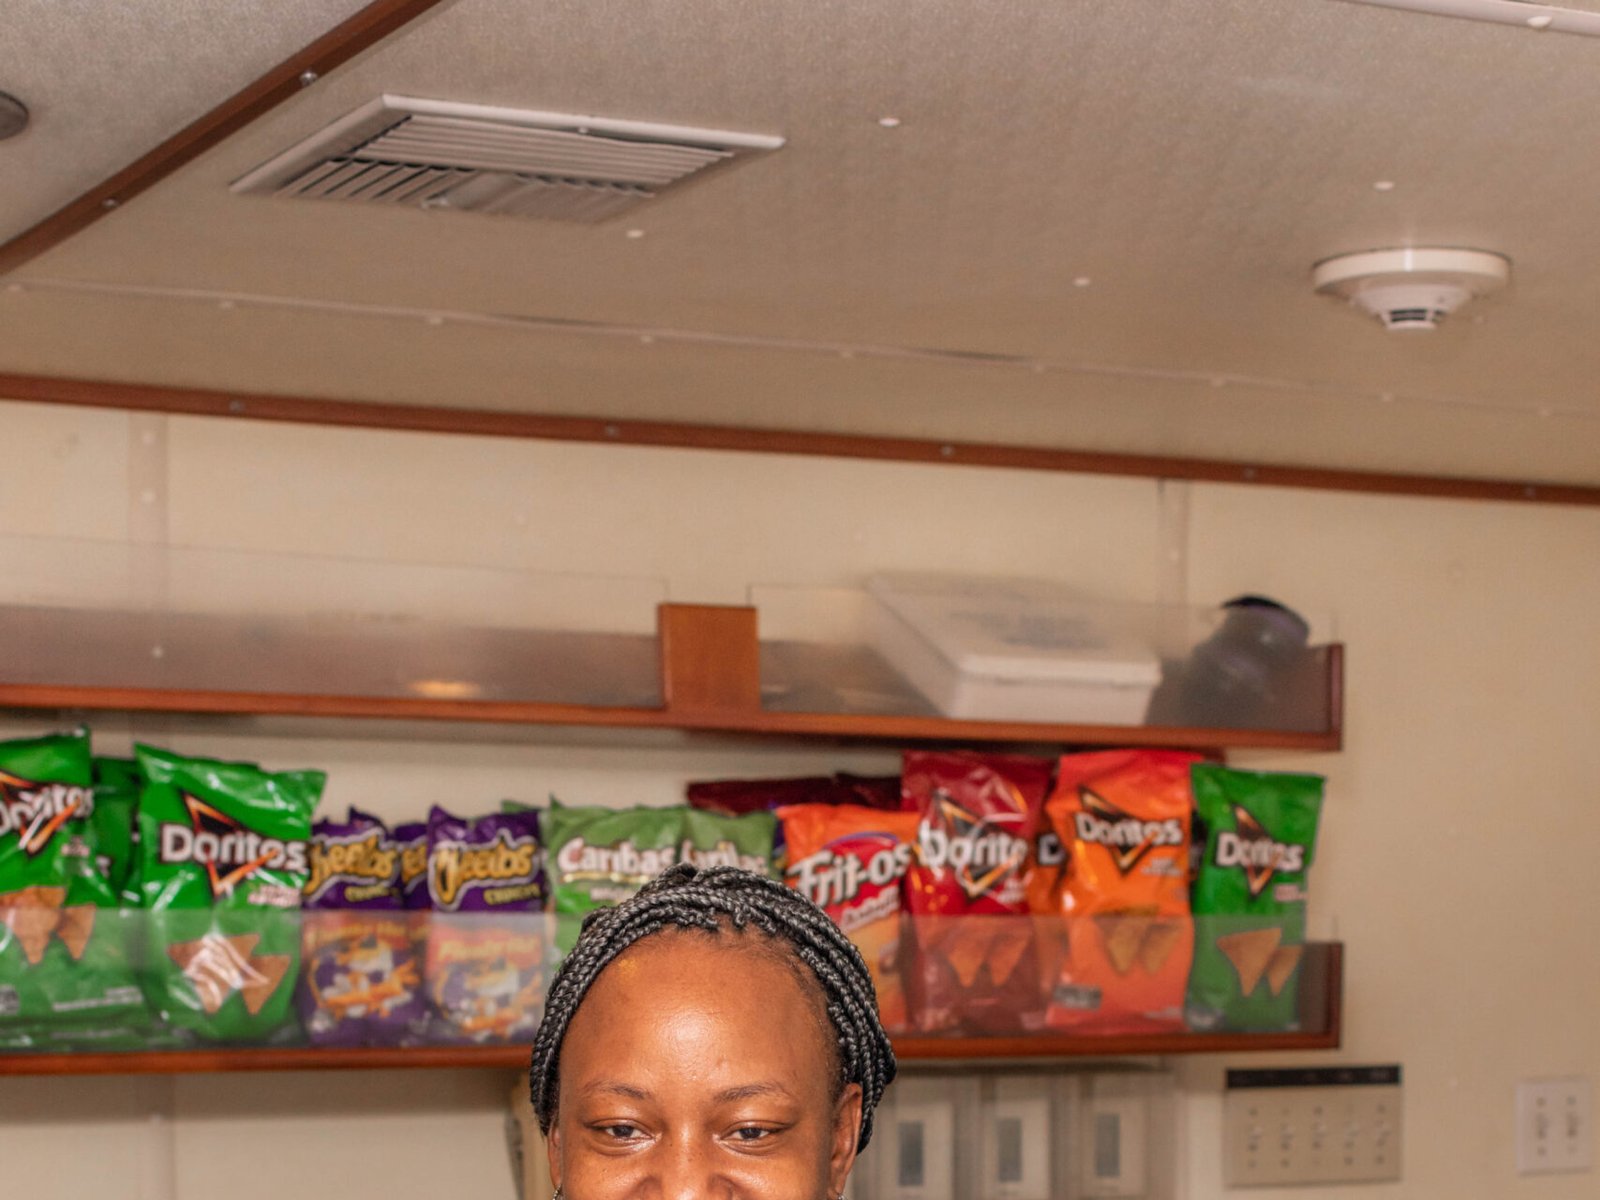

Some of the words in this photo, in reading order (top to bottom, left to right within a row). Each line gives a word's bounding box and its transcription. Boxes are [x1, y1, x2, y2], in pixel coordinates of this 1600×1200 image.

[161, 822, 307, 874] Doritos
[1076, 812, 1183, 846] Doritos
[434, 842, 536, 905] Cheetos
[1216, 832, 1304, 873] Doritos
